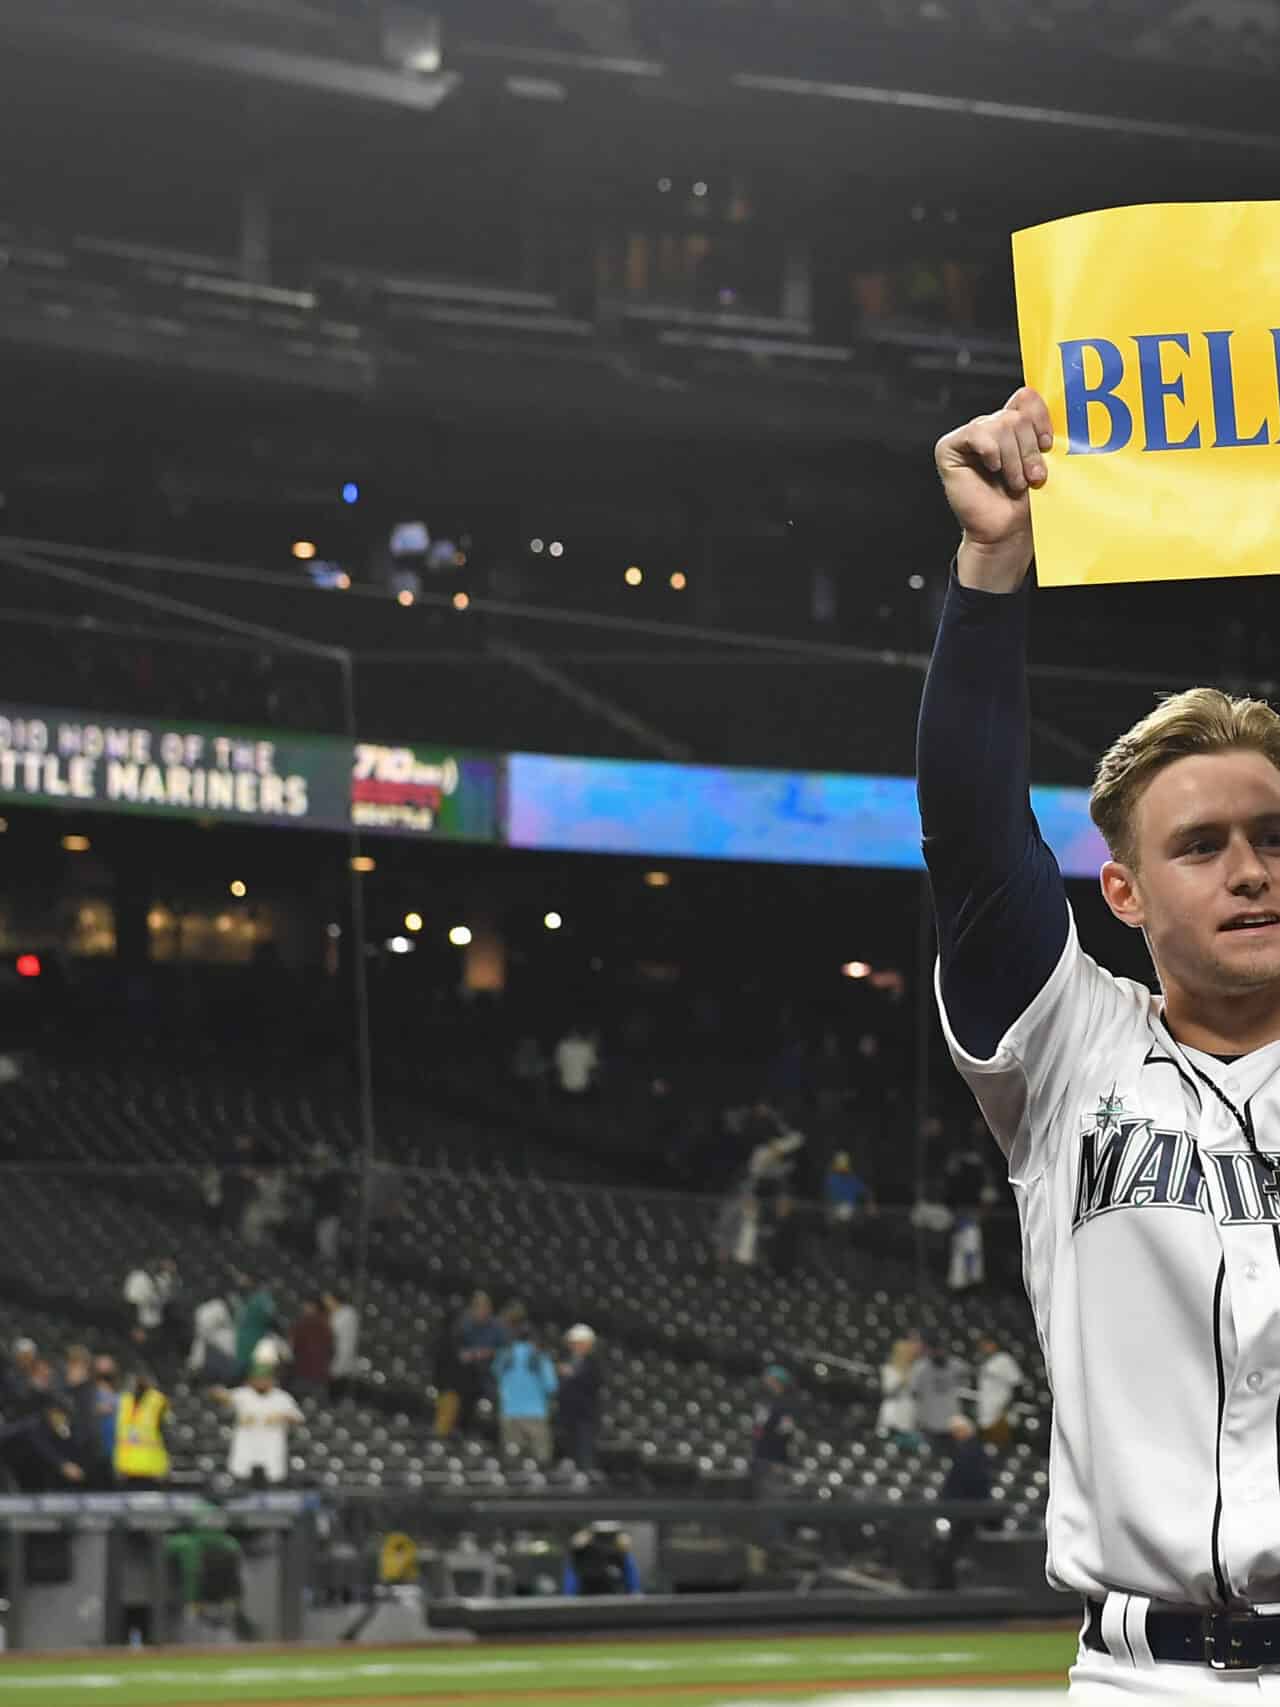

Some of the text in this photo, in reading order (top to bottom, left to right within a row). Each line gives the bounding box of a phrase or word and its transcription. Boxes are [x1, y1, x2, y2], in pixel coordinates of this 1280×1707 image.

[57, 723, 152, 765] HOME
[160, 732, 205, 768] OF
[213, 737, 274, 775] THE
[106, 760, 308, 817] MARINERS
